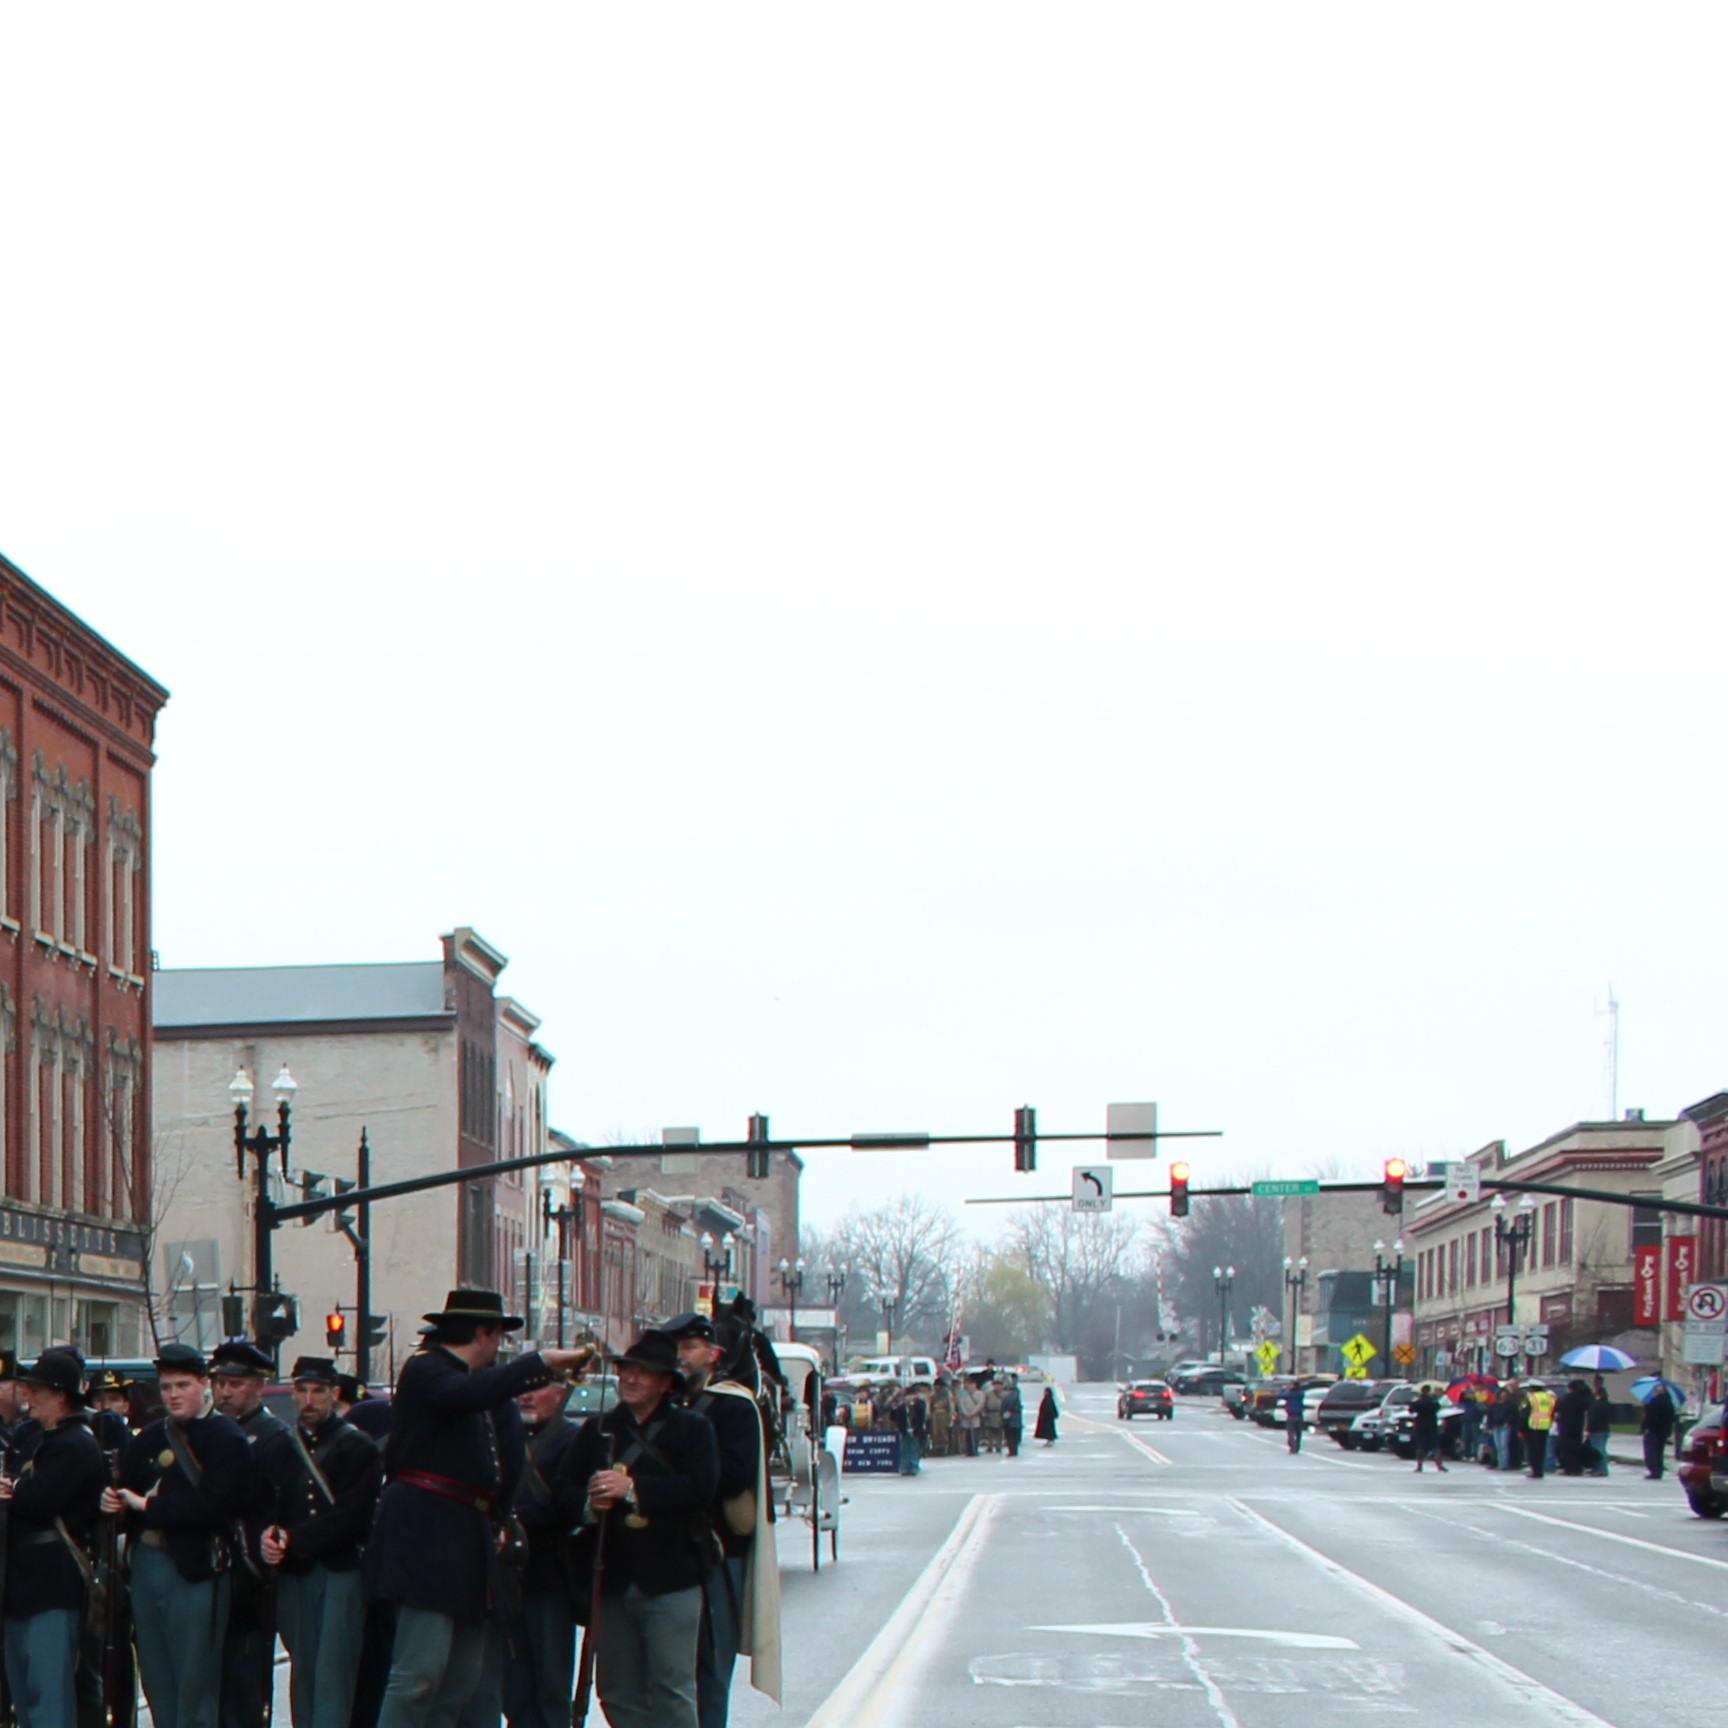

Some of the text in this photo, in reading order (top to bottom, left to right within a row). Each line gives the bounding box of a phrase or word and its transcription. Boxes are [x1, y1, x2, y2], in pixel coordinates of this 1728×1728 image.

[1258, 1184, 1301, 1194] CENTER
[1077, 1199, 1108, 1209] ONLY
[1498, 1340, 1518, 1353] 63
